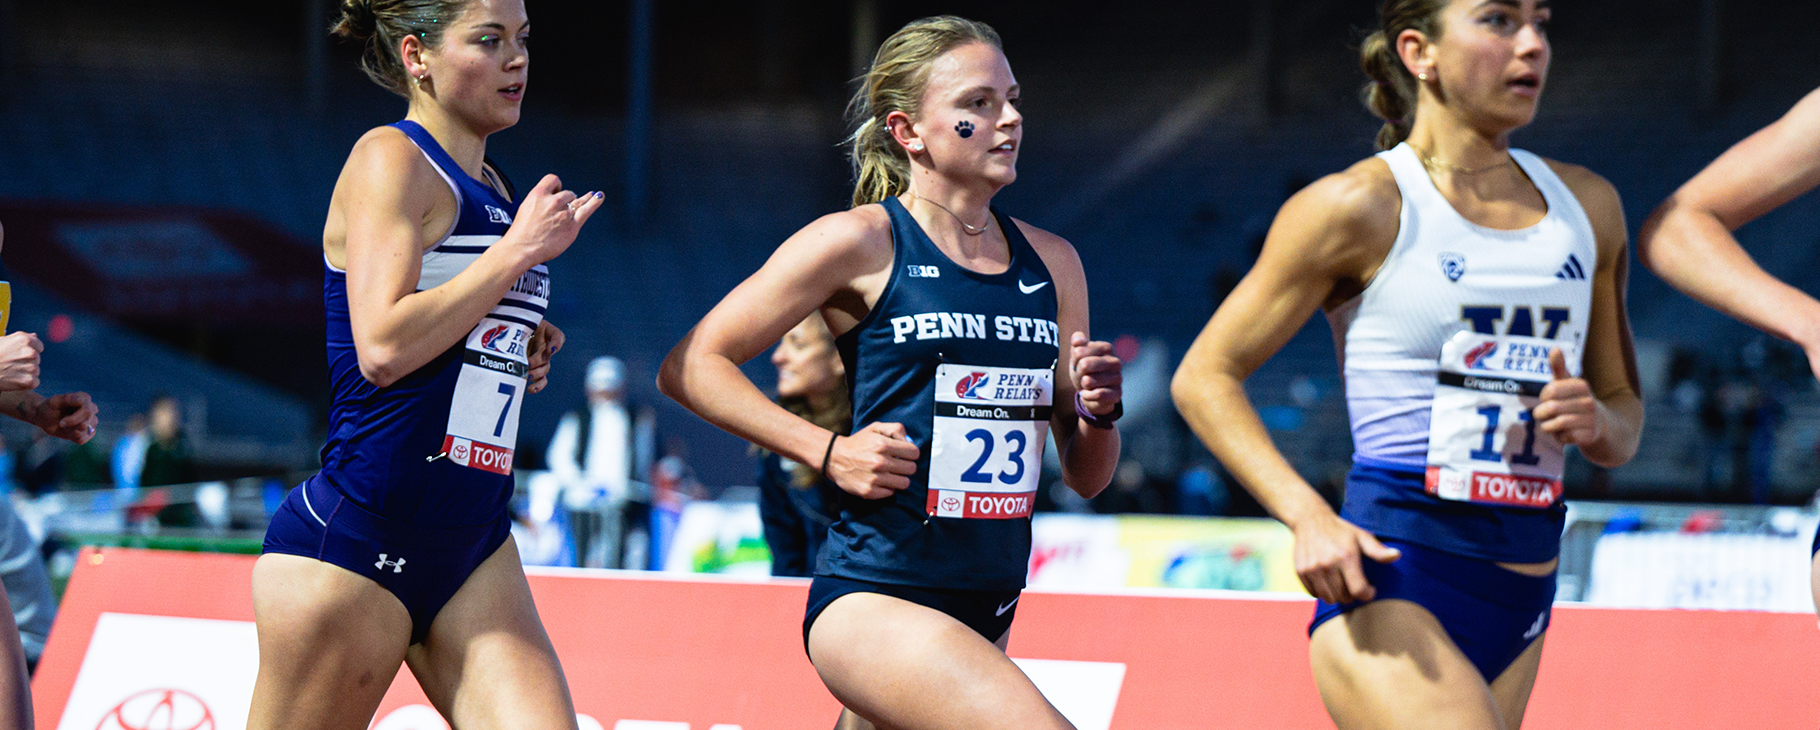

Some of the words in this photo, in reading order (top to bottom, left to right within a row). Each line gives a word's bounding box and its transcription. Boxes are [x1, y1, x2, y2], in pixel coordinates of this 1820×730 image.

[890, 312, 987, 344] PENN
[480, 354, 506, 371] Dream
[997, 373, 1035, 387] PENN
[1463, 375, 1502, 391] Dream
[993, 387, 1042, 400] RELAYS
[493, 382, 516, 438] 7
[956, 405, 992, 418] Dream
[994, 407, 1010, 419] On.
[1470, 404, 1540, 466] 11
[960, 428, 1027, 485] 23
[1475, 475, 1555, 505] TOYOTA
[969, 496, 1028, 514] TOYOTA
